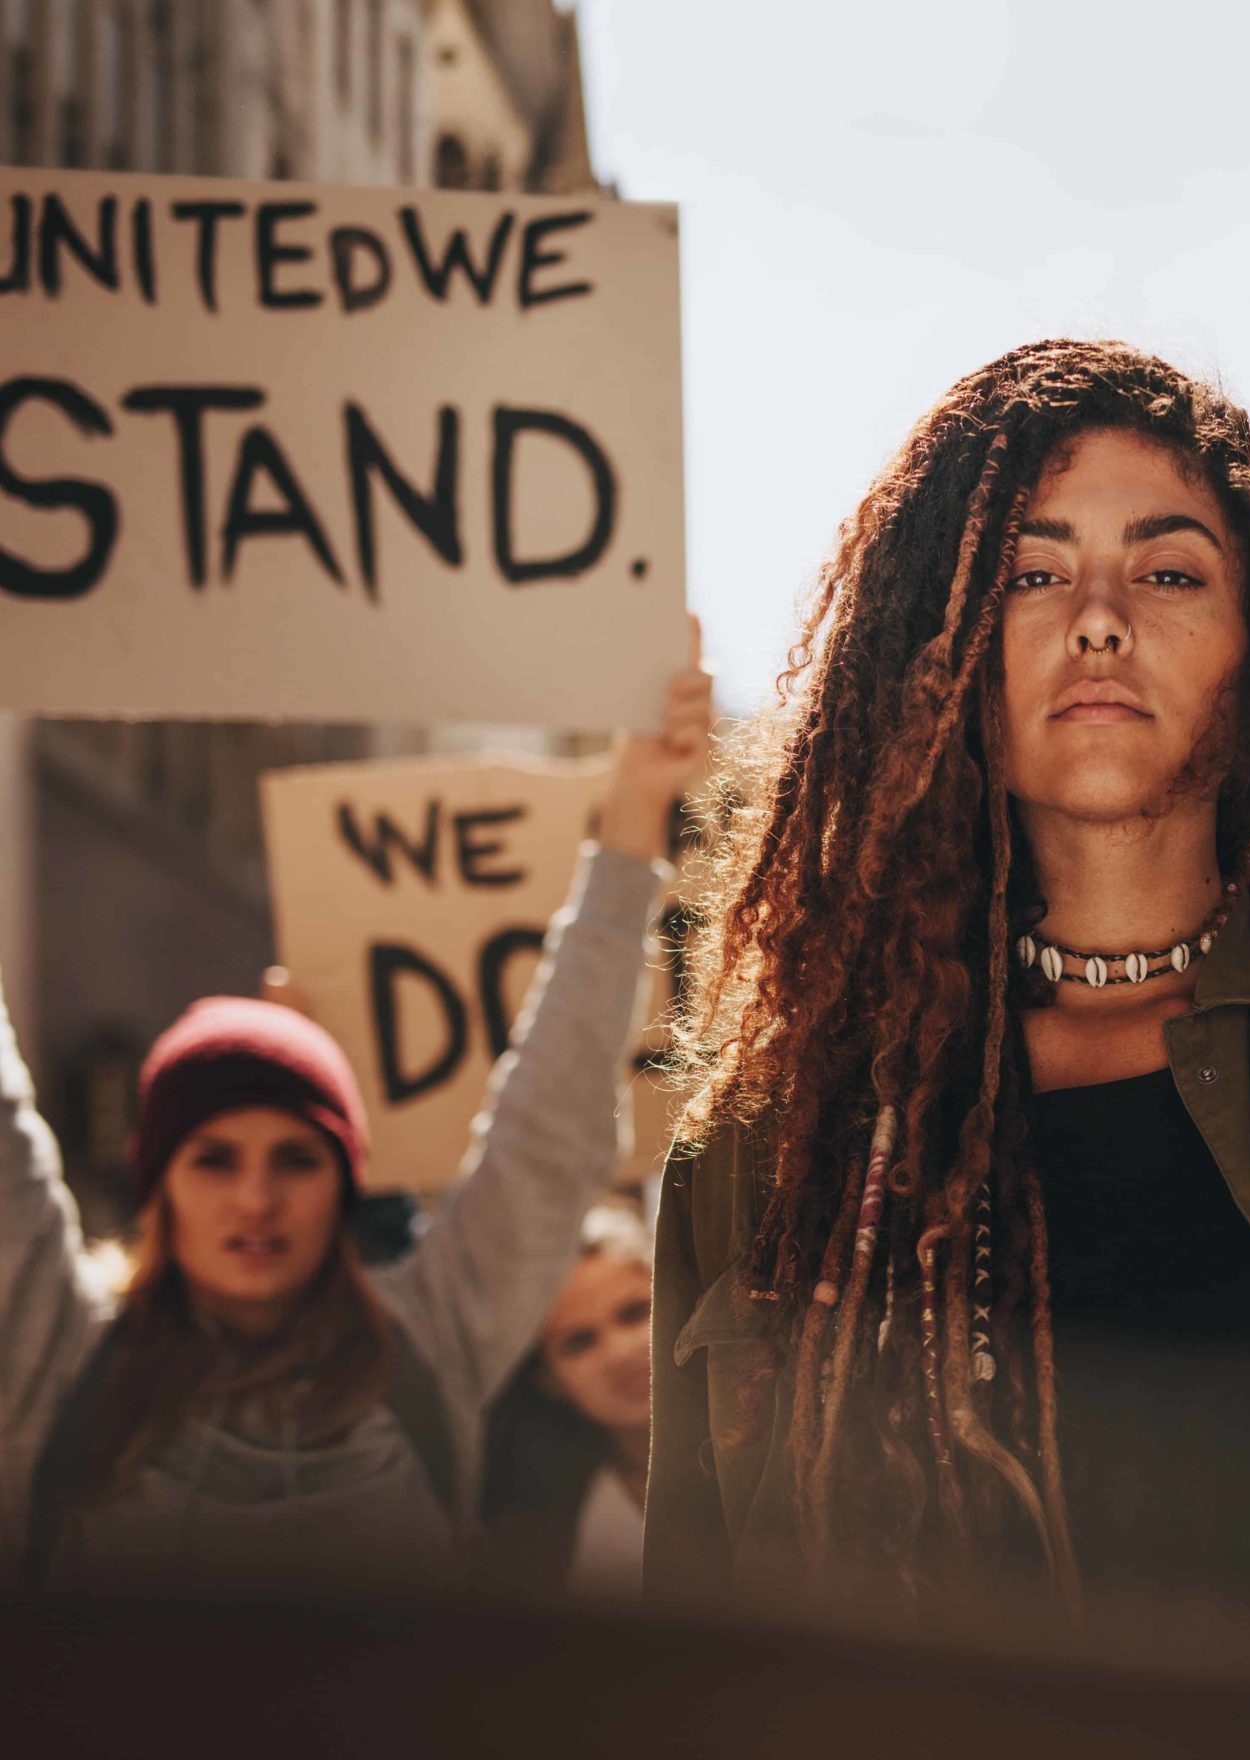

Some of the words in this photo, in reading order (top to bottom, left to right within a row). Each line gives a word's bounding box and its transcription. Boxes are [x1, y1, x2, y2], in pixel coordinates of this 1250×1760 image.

[399, 202, 594, 318] WE
[0, 374, 651, 607] STAND.
[336, 798, 526, 890] WE
